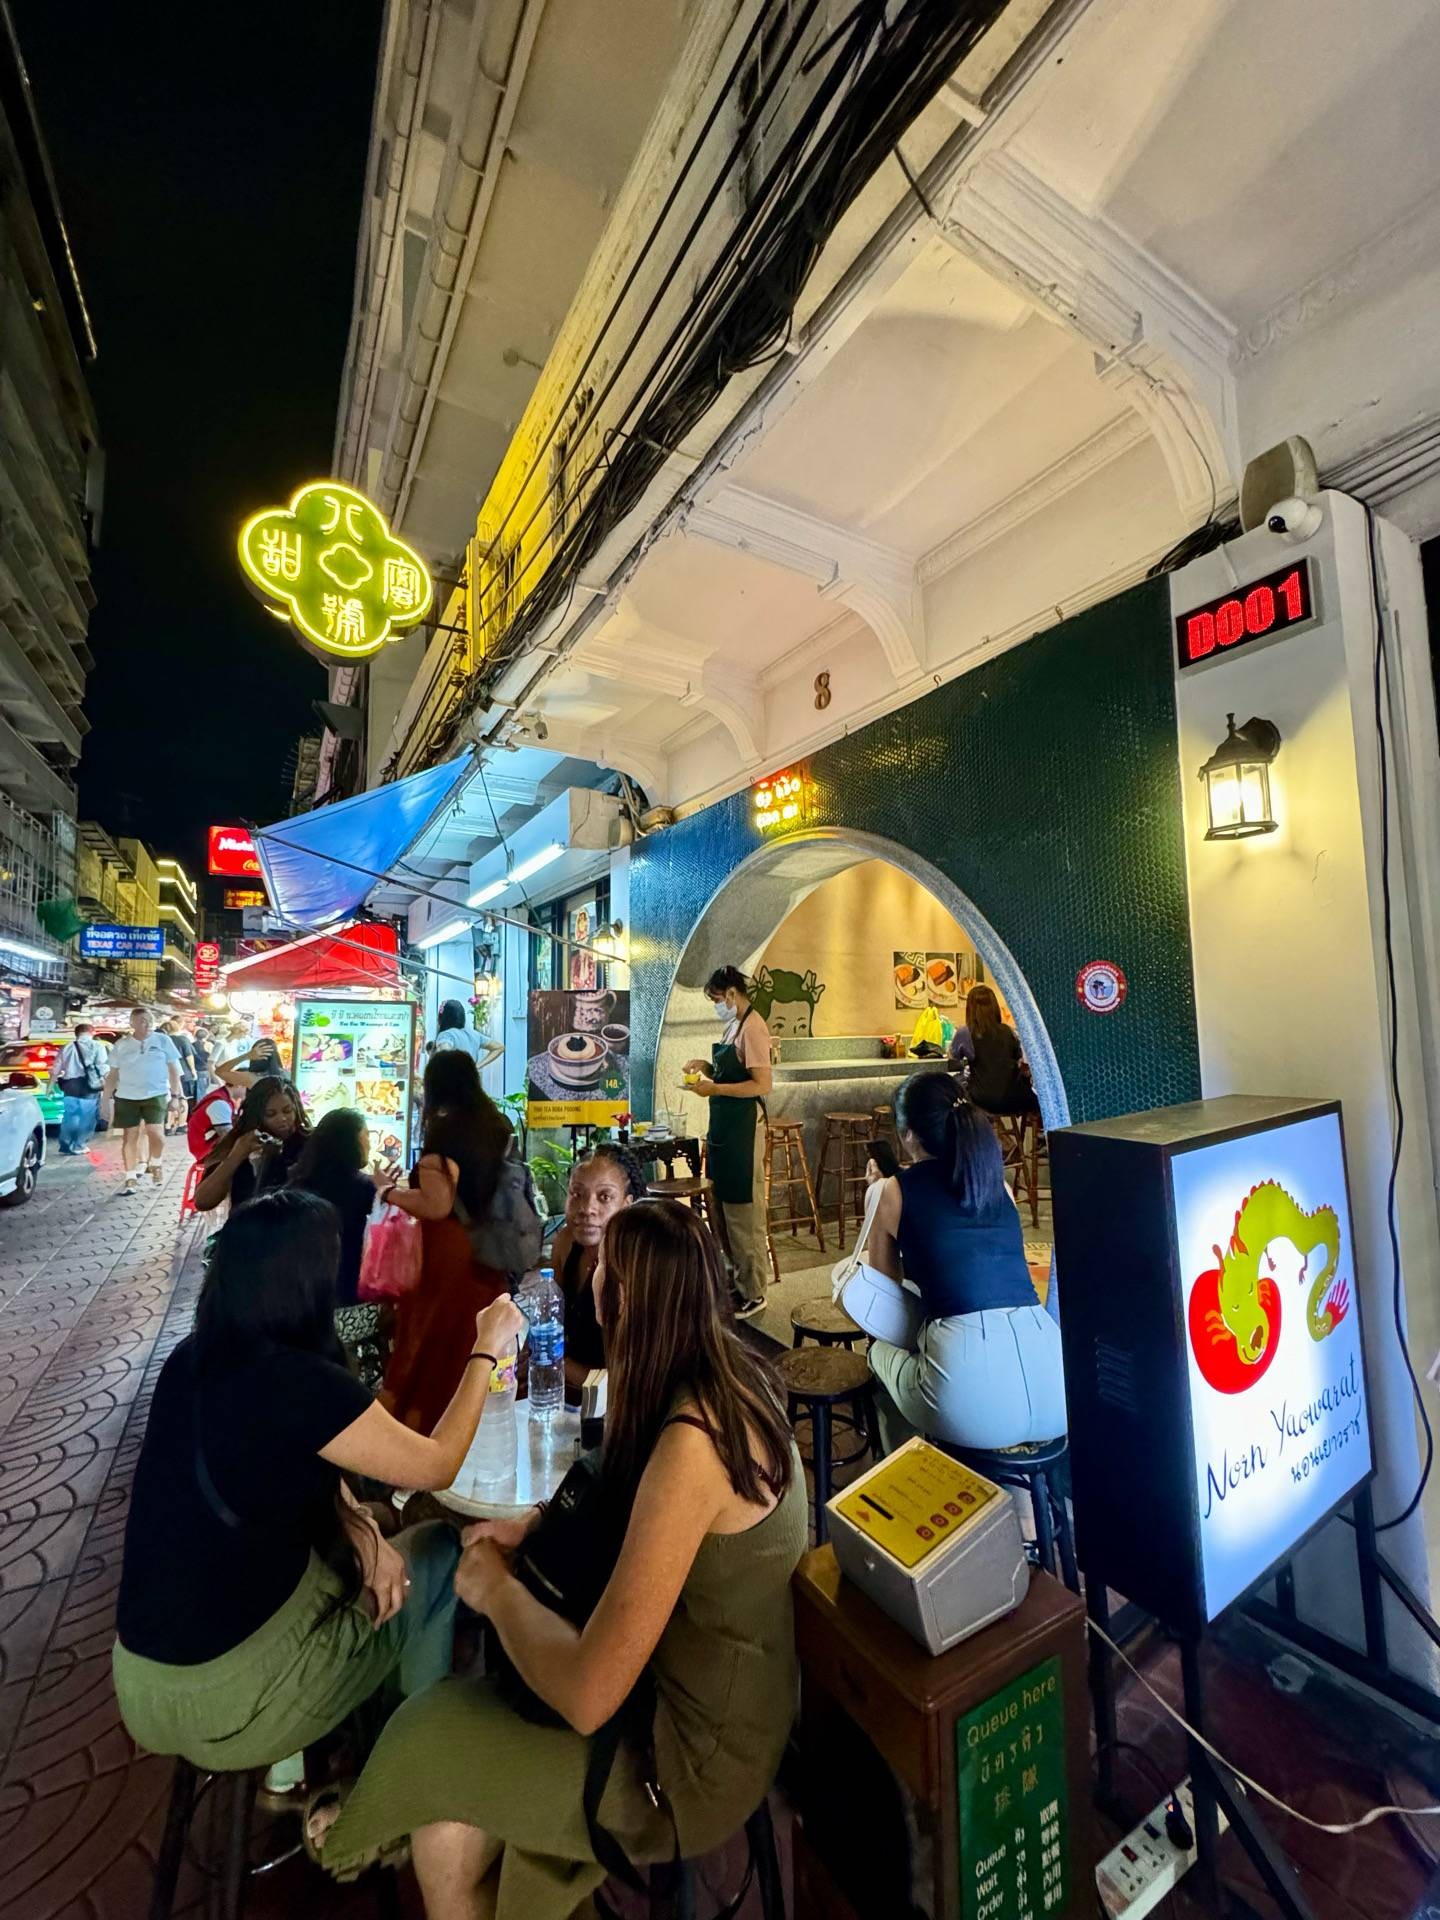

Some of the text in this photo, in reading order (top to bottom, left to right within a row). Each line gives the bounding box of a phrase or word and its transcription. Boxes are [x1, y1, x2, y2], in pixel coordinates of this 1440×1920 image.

[1187, 570, 1303, 661] D001
[813, 671, 832, 711] 8
[87, 940, 158, 951] TEXAS CAR PARK
[1270, 1352, 1359, 1457] Yaowarat
[967, 1675, 1056, 1748] Queue here
[975, 1844, 1007, 1878] Queue
[977, 1872, 998, 1901] Wait
[977, 1891, 1004, 1920] Order
